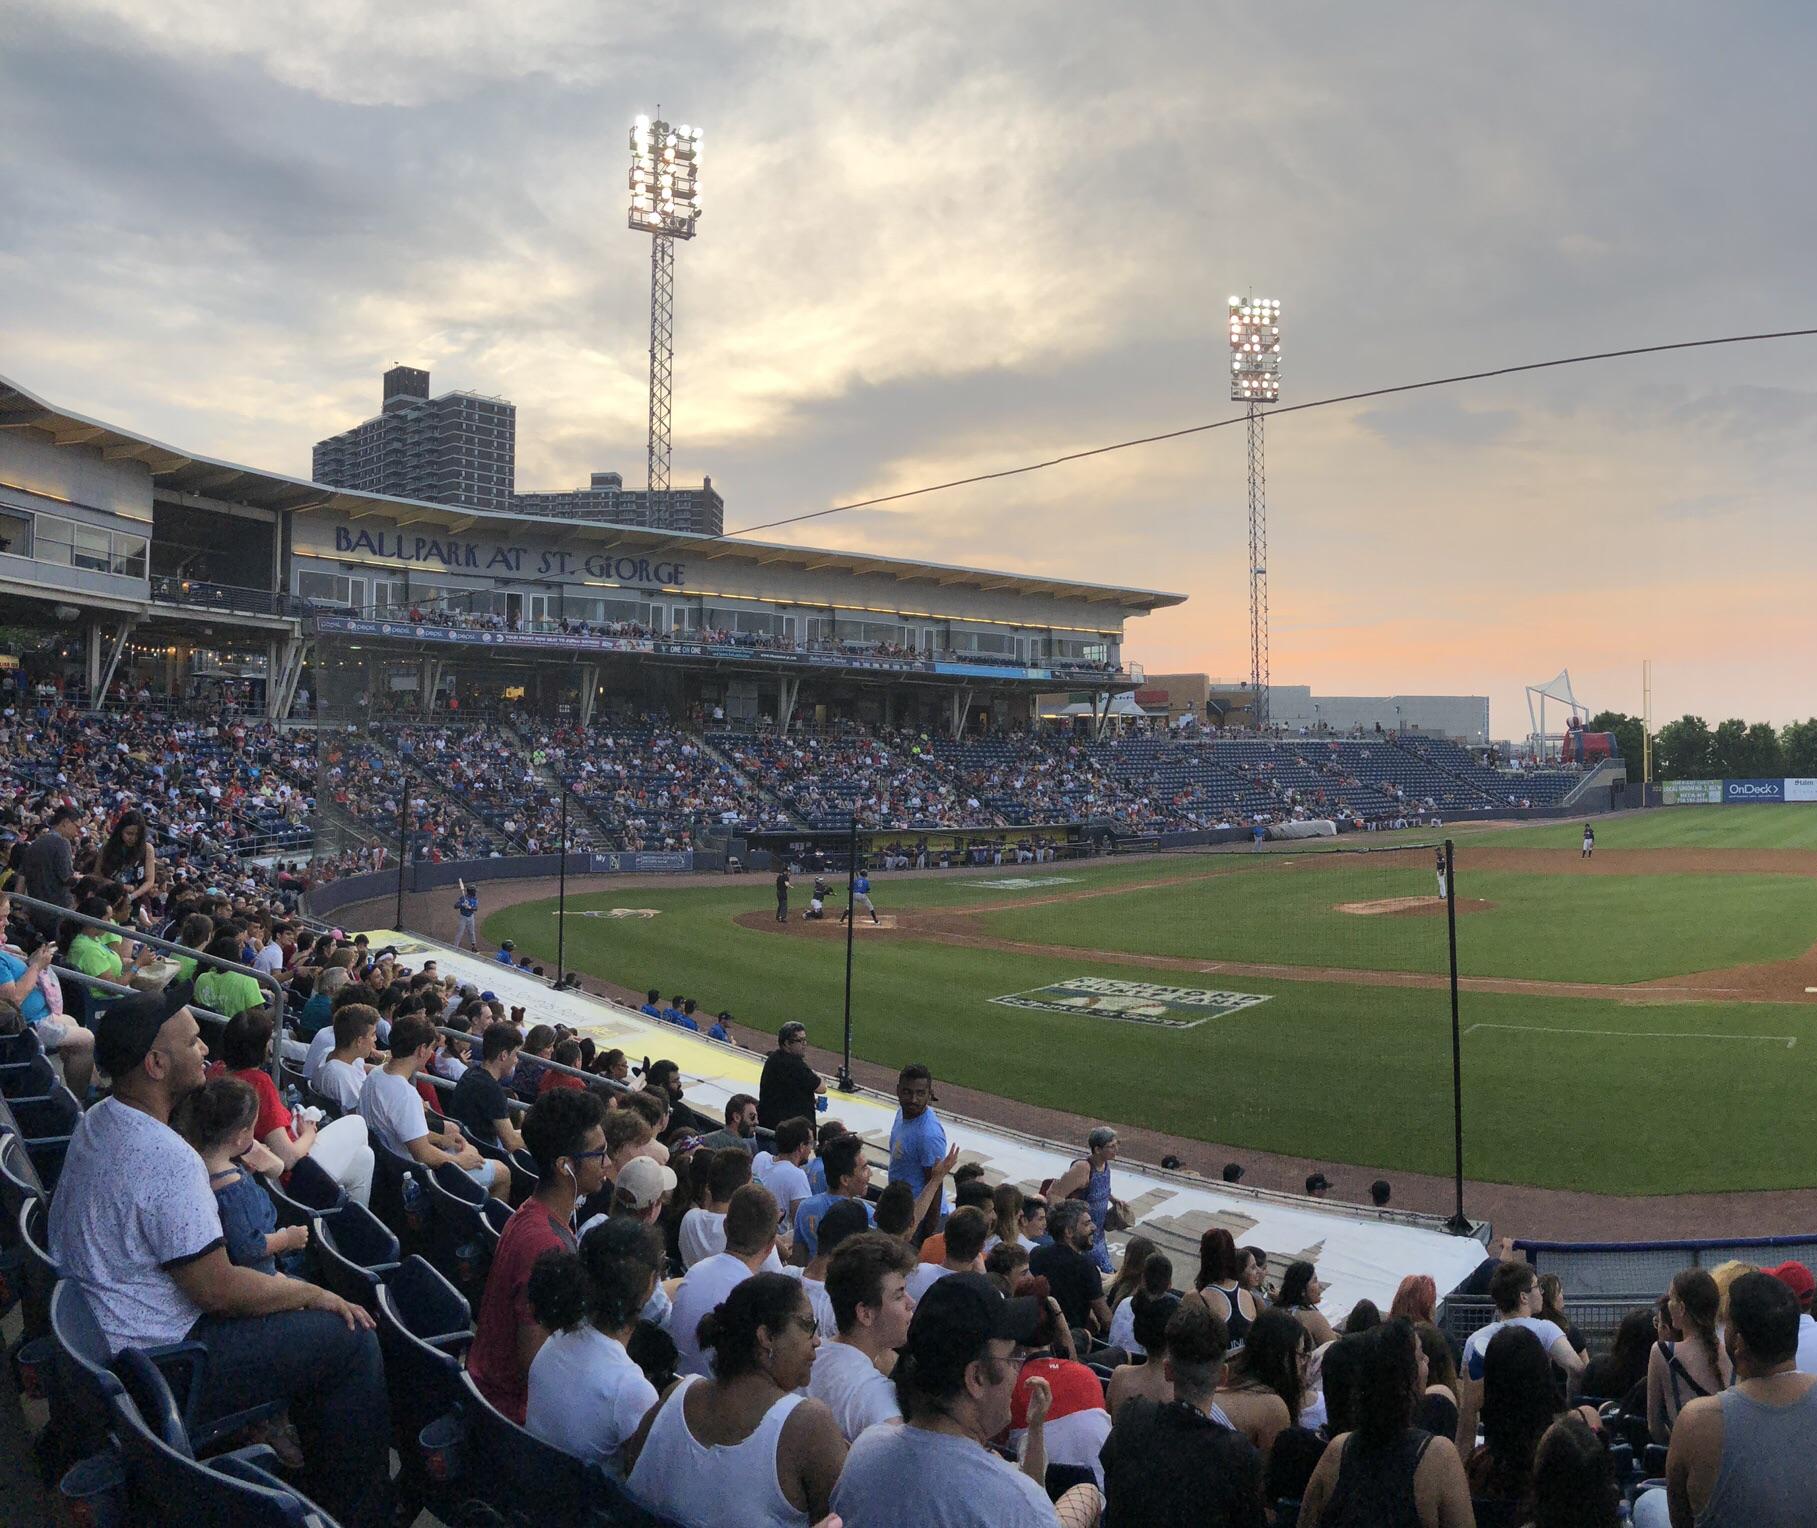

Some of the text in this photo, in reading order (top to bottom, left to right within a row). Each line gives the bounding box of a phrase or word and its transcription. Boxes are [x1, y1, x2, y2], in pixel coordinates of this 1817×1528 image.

[335, 526, 686, 586] BALLPARK AT ST. GEORGE
[425, 629, 443, 638] pepsi
[1729, 784, 1773, 794] OnDeck
[595, 854, 606, 863] My
[1075, 977, 1264, 1001] RICHMOND
